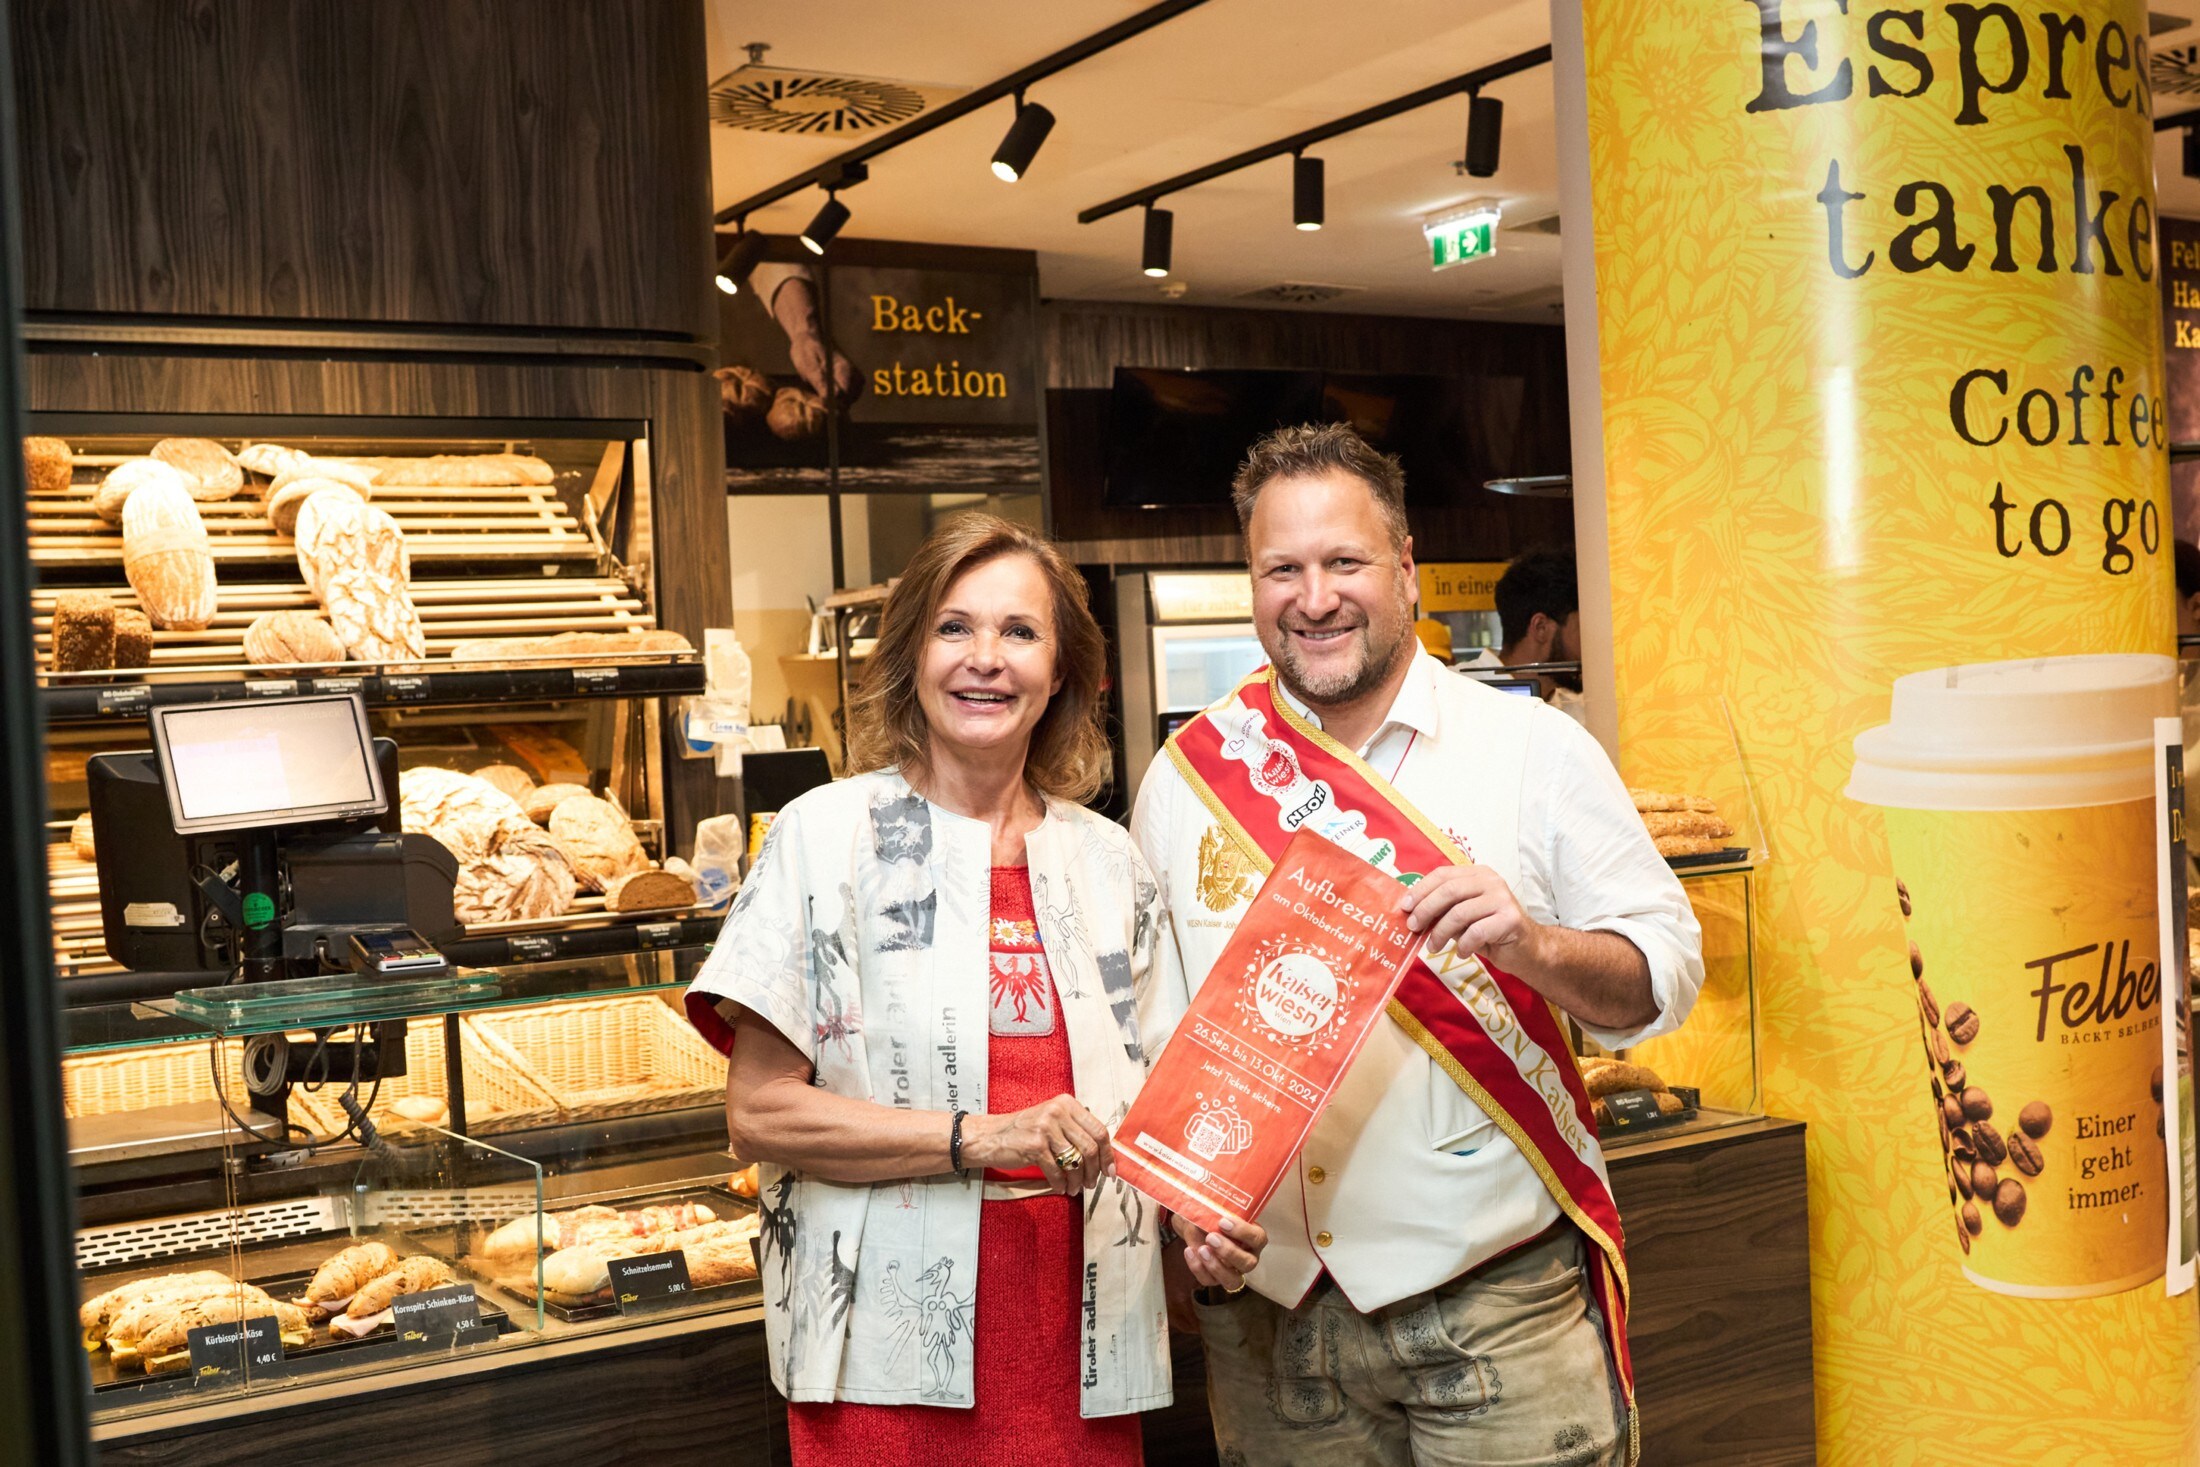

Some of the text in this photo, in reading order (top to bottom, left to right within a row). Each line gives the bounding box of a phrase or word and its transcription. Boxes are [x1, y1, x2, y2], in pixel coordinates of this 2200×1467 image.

[870, 295, 983, 334] Back-
[873, 360, 1007, 399] station
[1949, 365, 2164, 451] Coffee
[1989, 481, 2159, 575] to go
[1435, 576, 1452, 596] in
[1286, 784, 1326, 828] NEOH
[1287, 866, 1413, 949] Aufbrezelt is!
[1272, 892, 1398, 972] am Oktoberfest in Wien
[1259, 983, 1319, 1029] wiesn
[1267, 962, 1334, 1011] Kaiser
[1274, 1009, 1292, 1026] Wien
[937, 1006, 958, 1076] adlerin
[1426, 943, 1587, 1158] WIESN Kaiser
[2061, 1031, 2112, 1045] BÄCKT
[1193, 1022, 1319, 1104] 26.Sep. bis 13.Okt. 2024
[1200, 1060, 1223, 1078] Jetzt
[1224, 1071, 1251, 1095] Tickets
[2076, 1113, 2136, 1140] Einer
[2080, 1145, 2133, 1180] geht
[2068, 1181, 2143, 1210] immer.
[622, 1260, 673, 1276] Schnitzelsemmel
[668, 1282, 686, 1293] 5,00 €
[394, 1294, 475, 1314] Kornspitz Schinken-Käse
[1082, 1262, 1098, 1332] adlerin
[205, 1329, 263, 1346] Kürbisspiz Käse
[456, 1318, 475, 1330] 4,50 €
[256, 1352, 276, 1365] 4,40 €
[1082, 1336, 1098, 1390] tiroler
